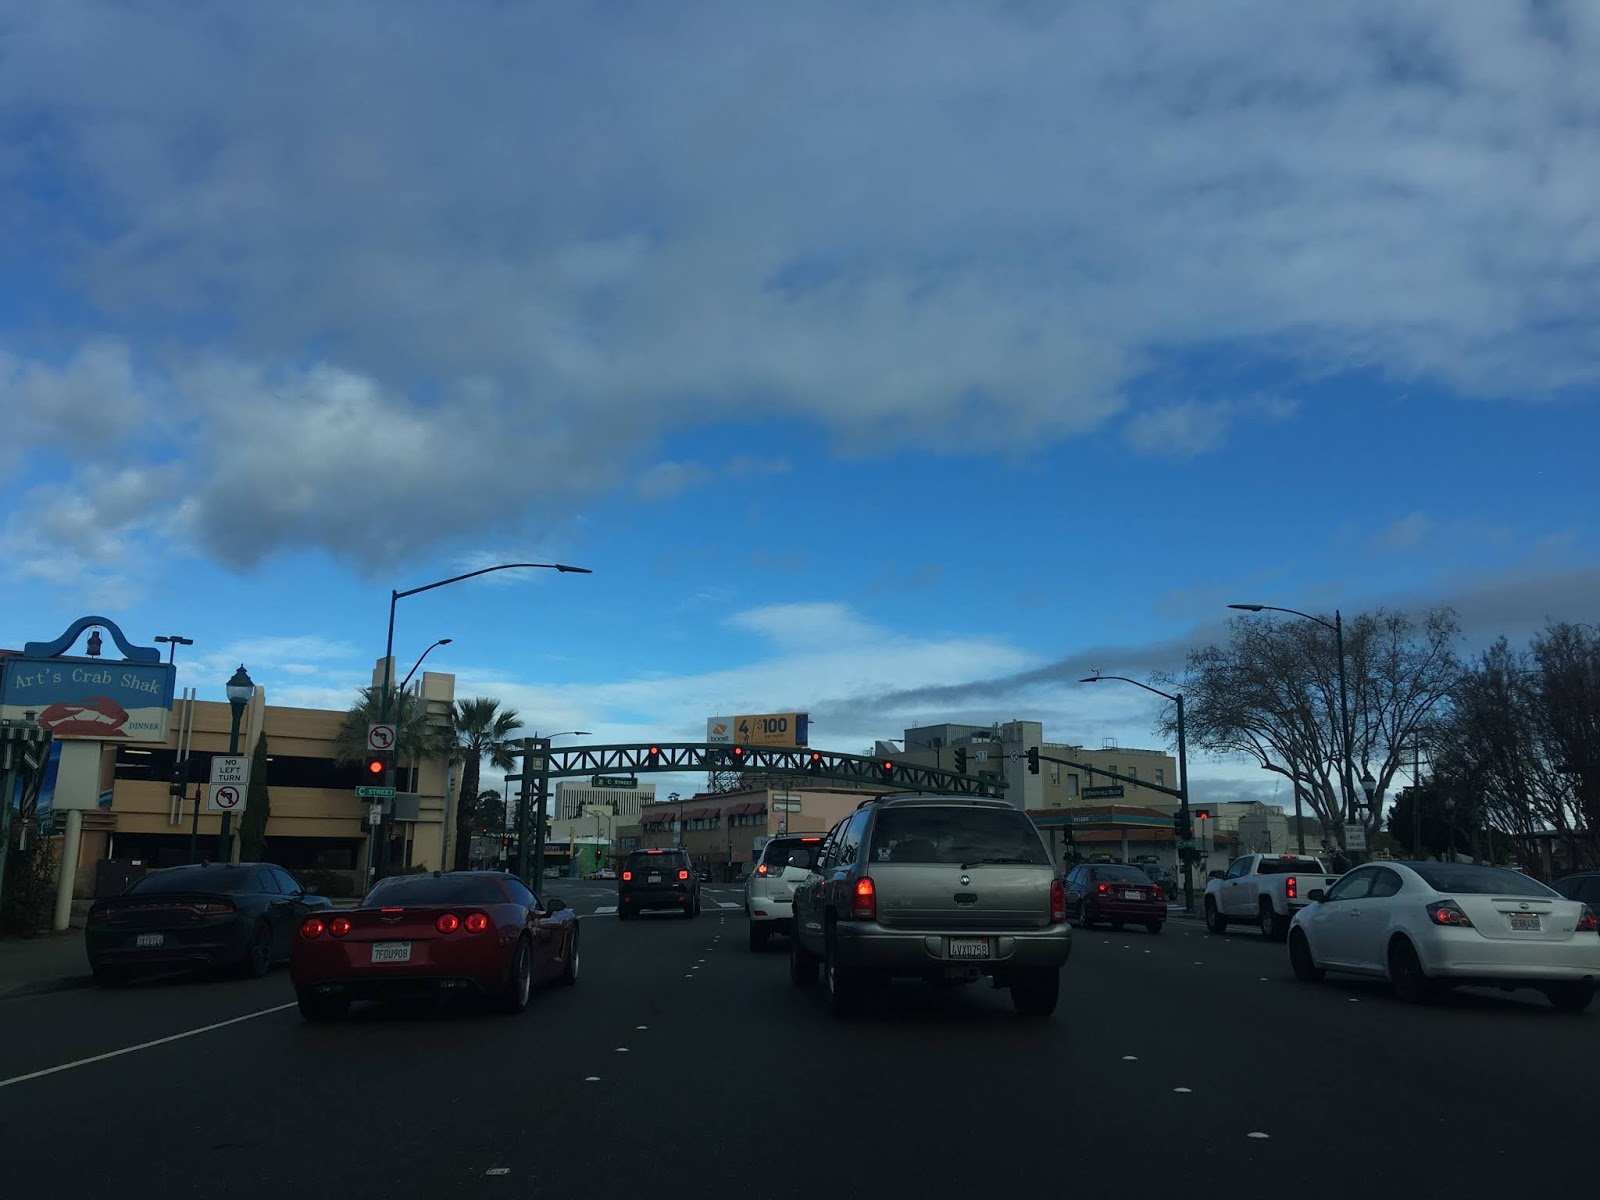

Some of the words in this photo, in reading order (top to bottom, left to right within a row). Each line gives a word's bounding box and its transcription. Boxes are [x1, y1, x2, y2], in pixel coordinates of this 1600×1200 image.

[15, 668, 62, 689] Art's
[72, 668, 112, 685] Crab
[120, 673, 161, 694] Shak
[128, 721, 160, 730] DINNER
[358, 787, 366, 795] C
